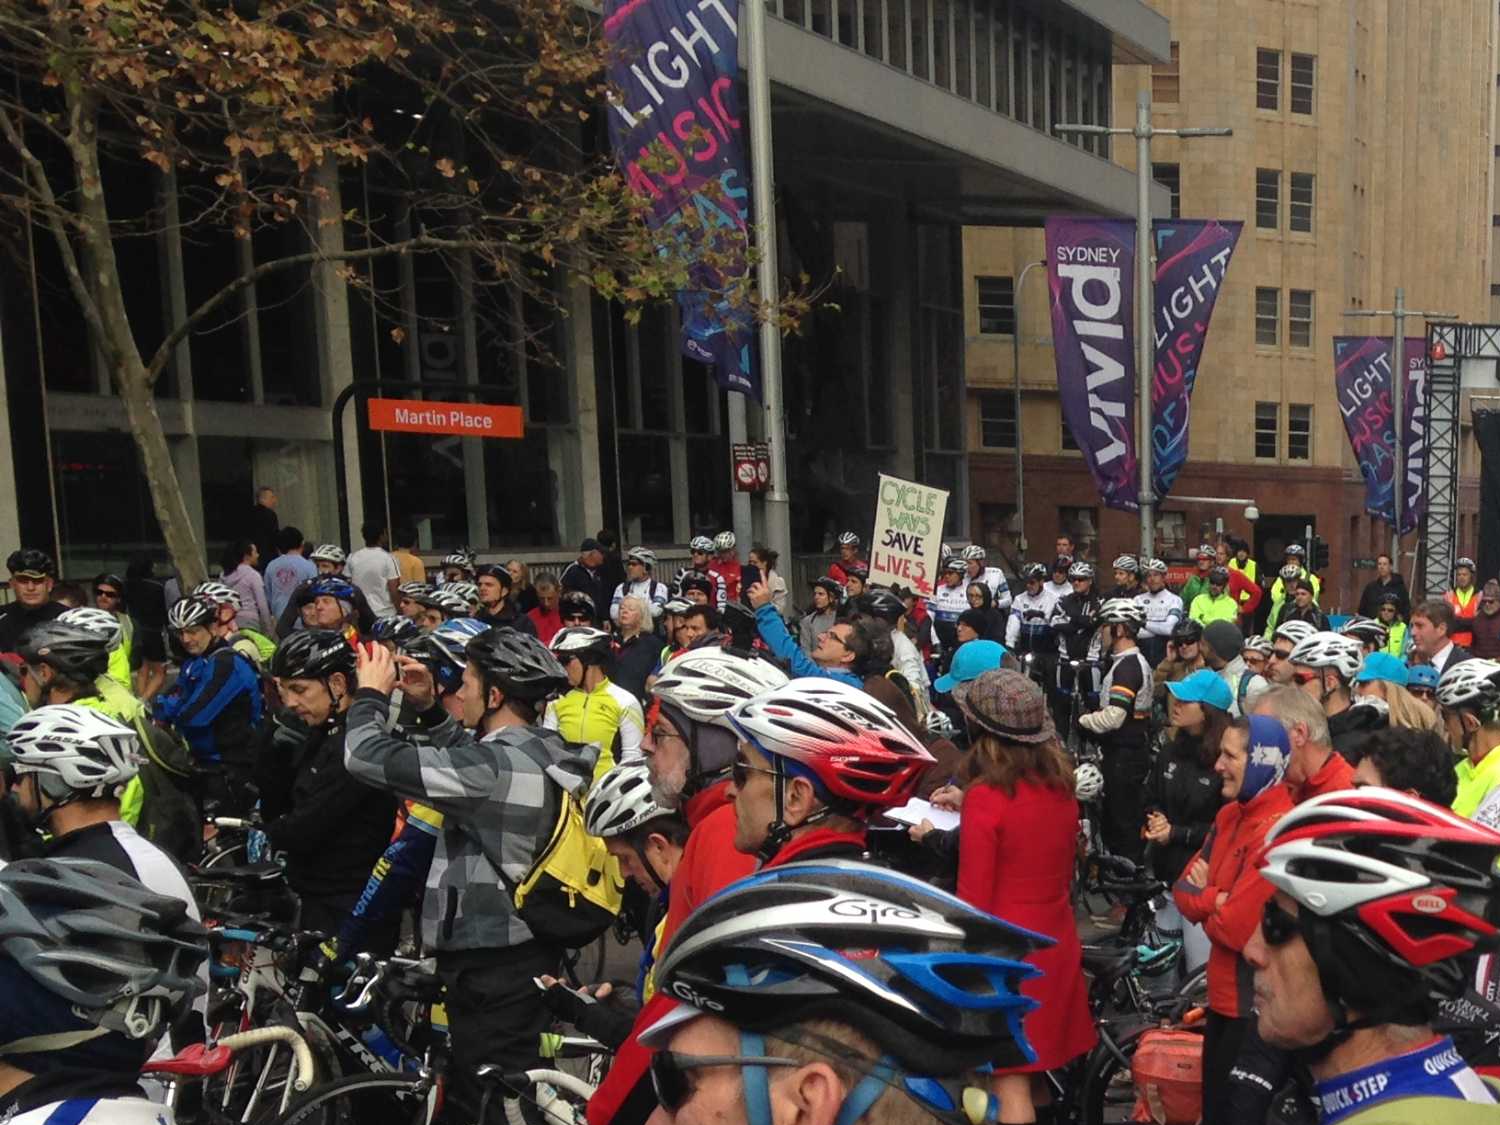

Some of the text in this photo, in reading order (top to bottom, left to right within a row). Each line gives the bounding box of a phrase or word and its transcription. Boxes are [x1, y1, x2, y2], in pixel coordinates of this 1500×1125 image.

[606, 0, 738, 128] LIGHT
[1057, 247, 1120, 263] SYDNEY
[1154, 247, 1231, 349] LIGHT
[1057, 263, 1126, 466] vivid
[1339, 352, 1392, 417] LIGHT
[395, 408, 493, 428] Martin Place
[881, 481, 936, 515] CYCLE
[881, 529, 924, 557] SAVE
[874, 551, 926, 579] LIVES
[829, 899, 920, 924] Giro
[1417, 898, 1442, 909] BELL
[672, 981, 724, 1011] Giro
